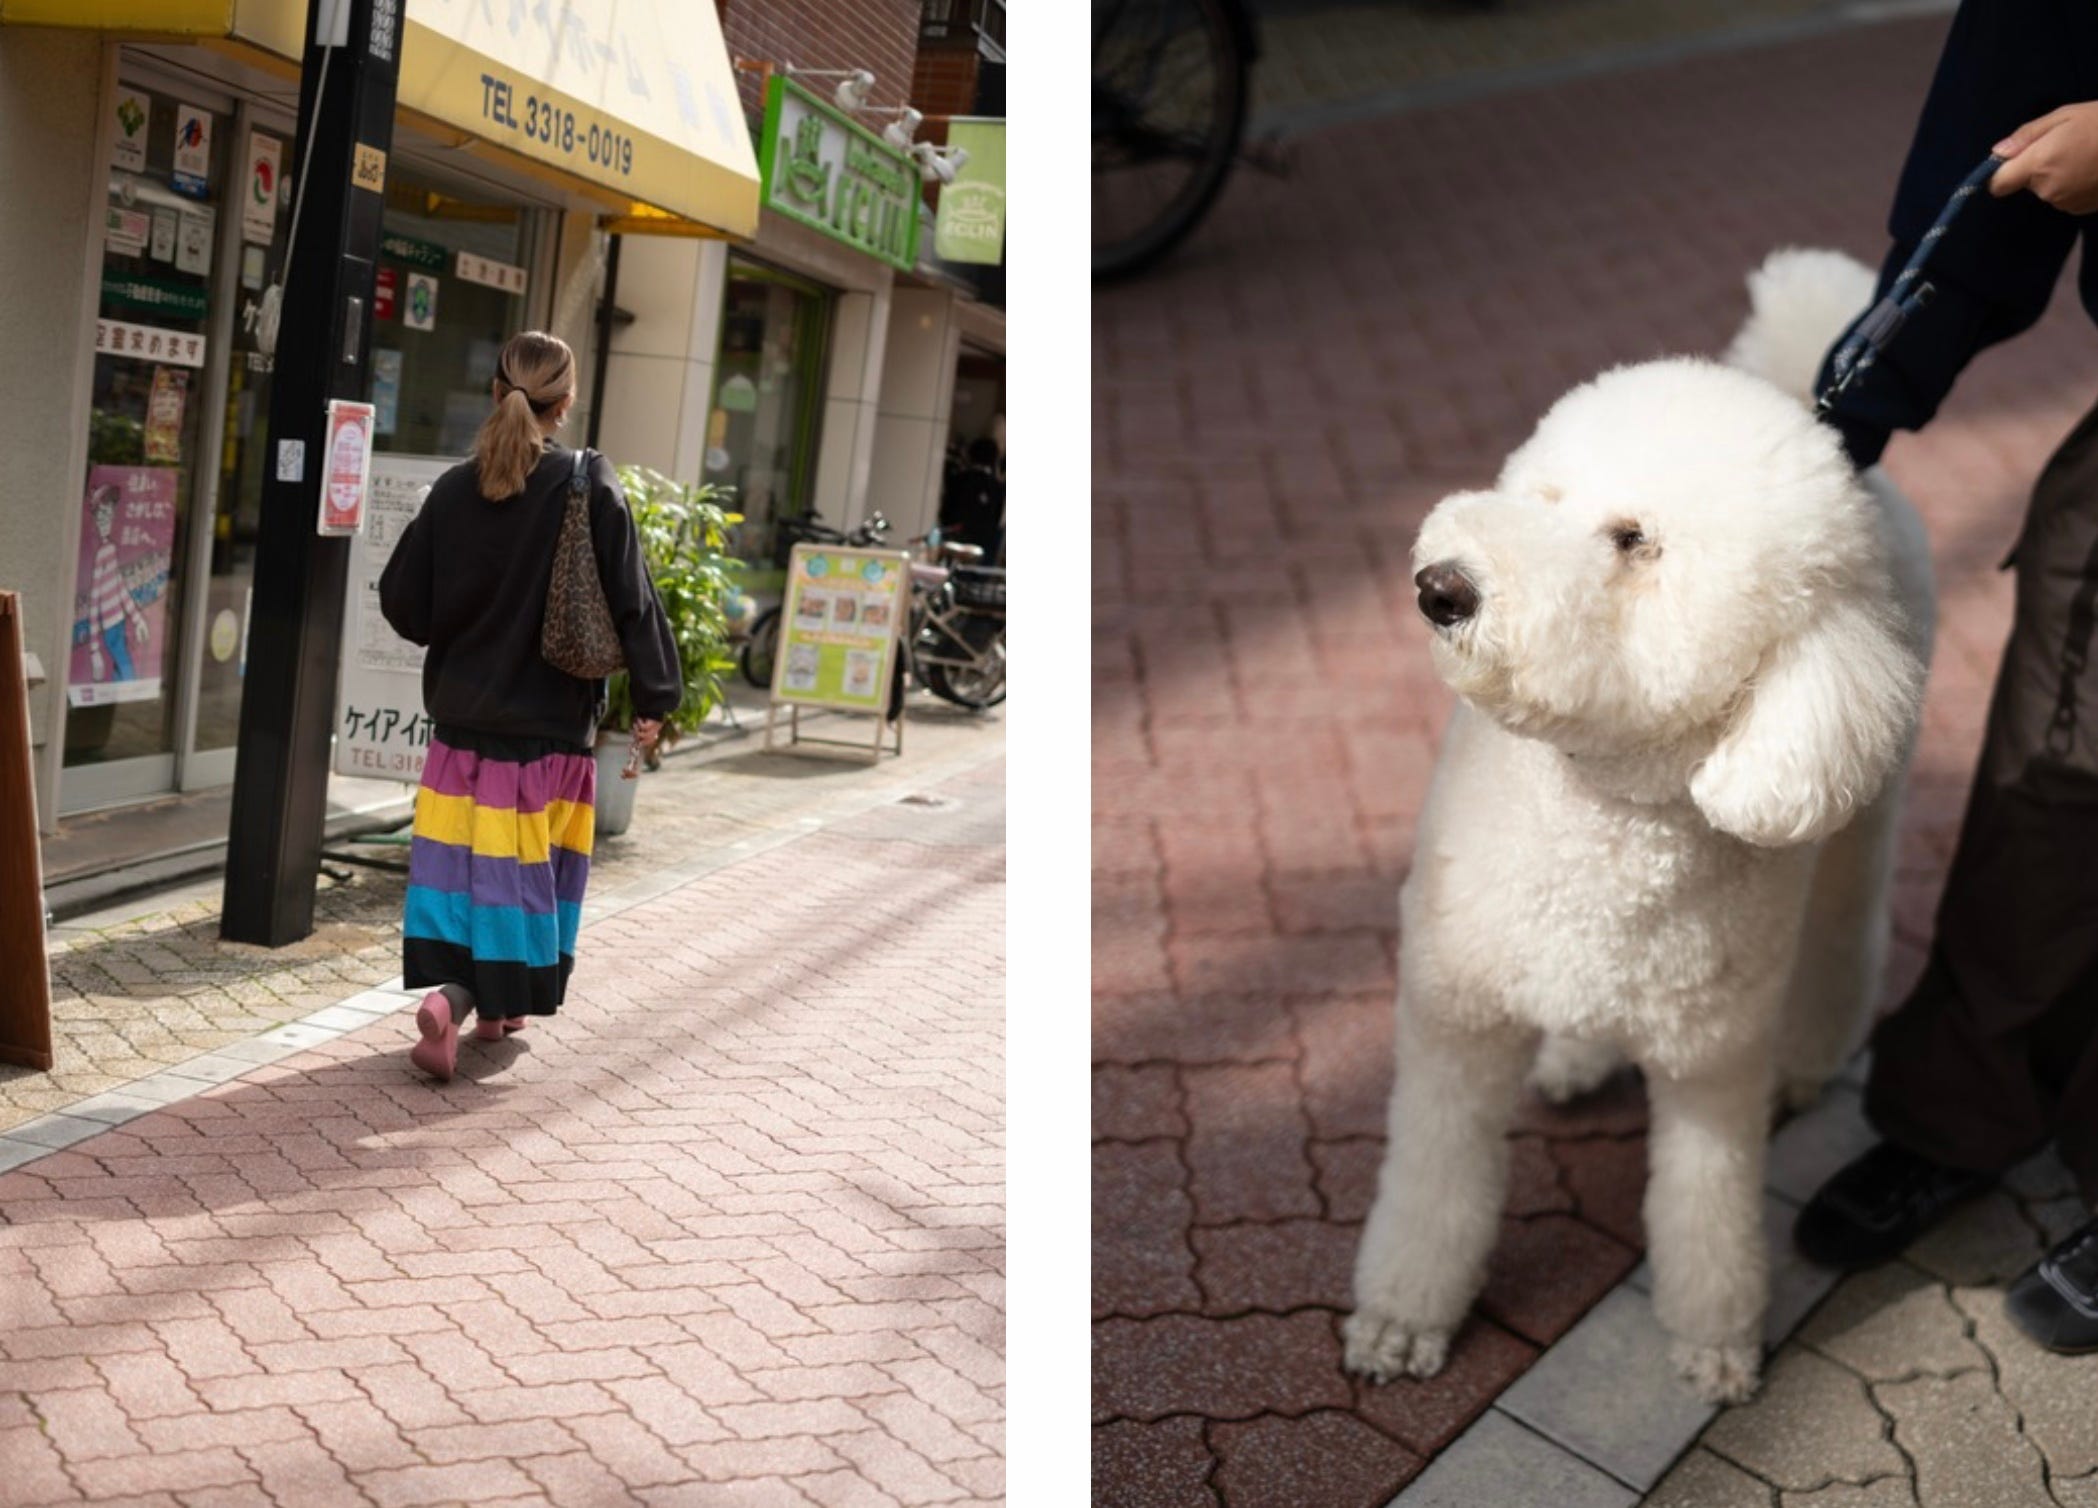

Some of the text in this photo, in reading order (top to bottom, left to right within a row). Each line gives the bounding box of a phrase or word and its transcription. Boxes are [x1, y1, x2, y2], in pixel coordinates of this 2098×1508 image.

[480, 73, 518, 130] TEL
[524, 95, 633, 176] 3318-0019
[350, 747, 386, 769] TEL
